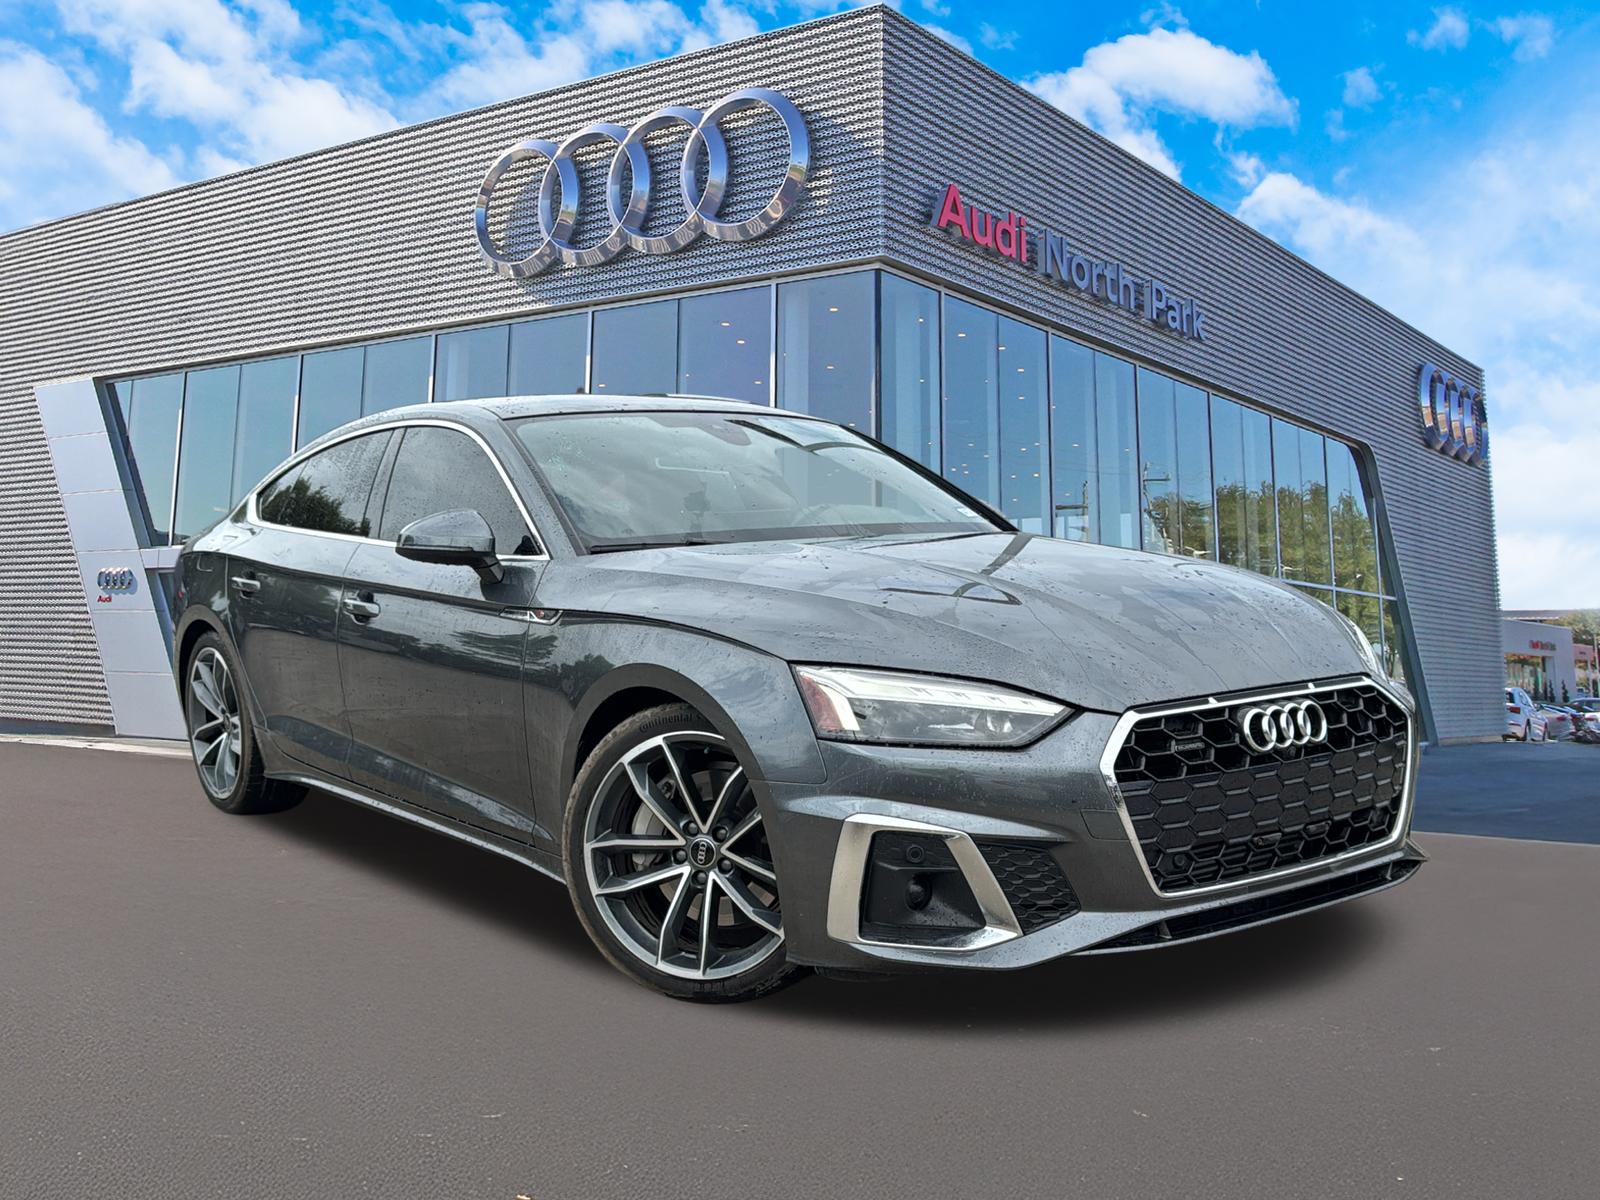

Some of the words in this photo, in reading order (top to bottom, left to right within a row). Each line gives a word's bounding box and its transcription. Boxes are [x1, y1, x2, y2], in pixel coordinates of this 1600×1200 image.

[931, 183, 1027, 263] Audi
[1038, 229, 1136, 310] North
[1144, 279, 1206, 340] Park
